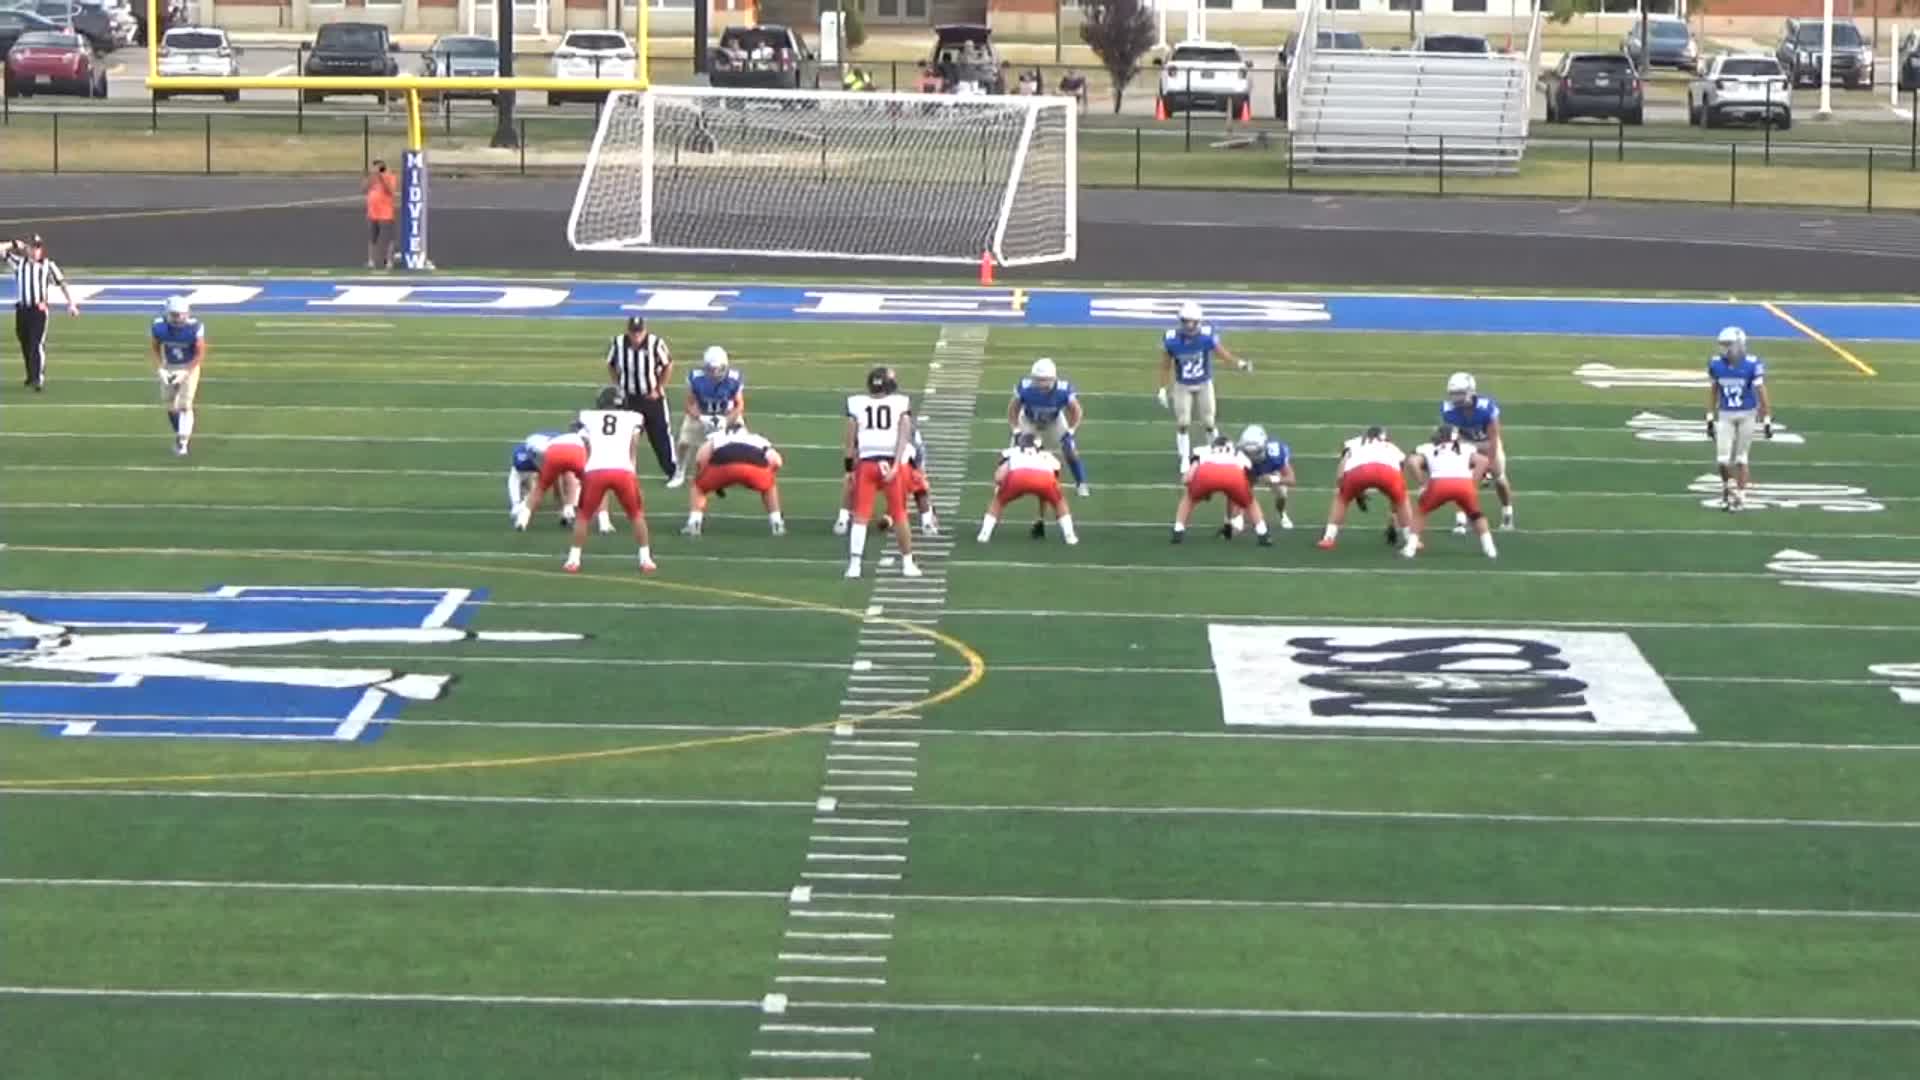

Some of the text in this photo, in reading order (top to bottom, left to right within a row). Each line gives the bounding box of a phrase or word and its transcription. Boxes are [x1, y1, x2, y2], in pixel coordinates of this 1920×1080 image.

[404, 152, 425, 270] MIDVIEW
[602, 413, 618, 436] 8
[864, 405, 892, 431] 10
[1286, 636, 1598, 723] ROSS
